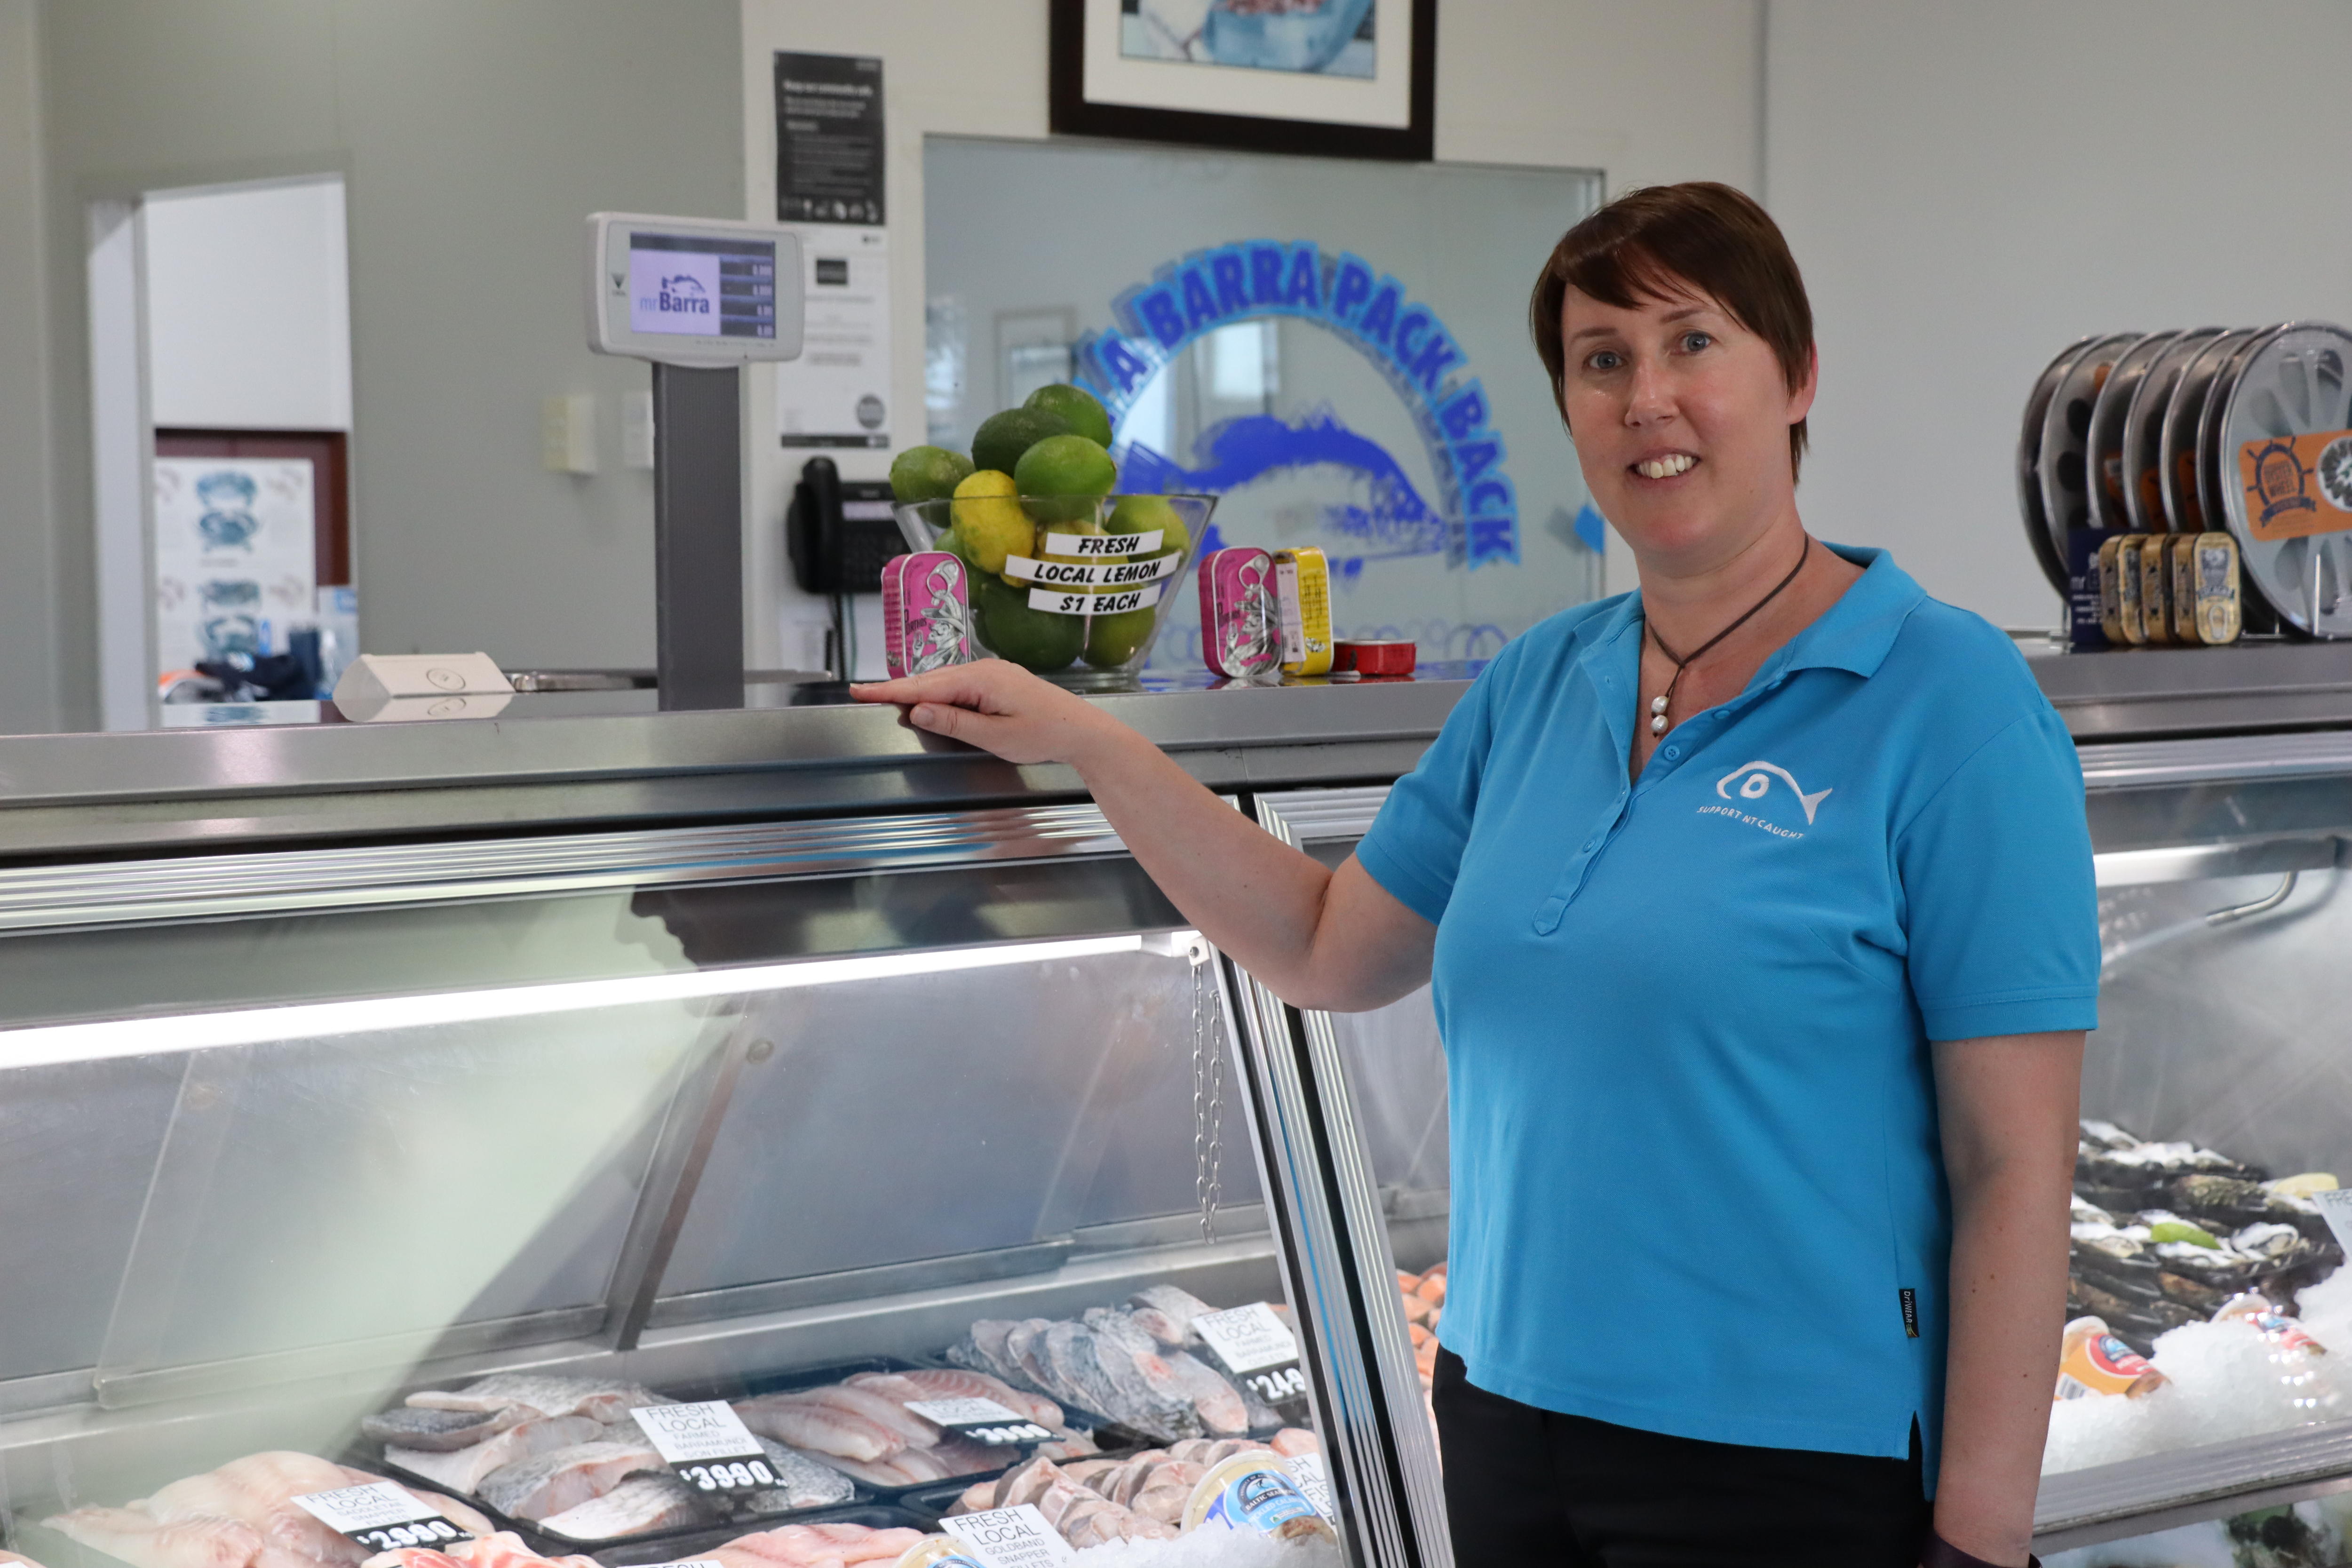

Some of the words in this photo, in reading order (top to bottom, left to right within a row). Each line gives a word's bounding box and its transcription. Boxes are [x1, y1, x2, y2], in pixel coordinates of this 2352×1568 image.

[1136, 242, 1322, 353] BARRA
[1333, 255, 1462, 396] PACK
[1437, 383, 1516, 565] BACK
[1078, 535, 1140, 555] FRESH
[1035, 564, 1095, 583] LOCAL
[1103, 560, 1162, 583] LEMON
[1060, 596, 1084, 612] $1
[1093, 592, 1141, 612] EACH
[1696, 806, 1742, 819] SUPPORT
[1757, 820, 1804, 839] CAUGHT
[1204, 1307, 1260, 1328] FRESH
[1217, 1321, 1272, 1341] LOCAL
[646, 1404, 715, 1420] FRESH
[659, 1417, 727, 1433] LOCAL
[674, 1430, 721, 1440] FARMED
[675, 1437, 747, 1450] BARRAMUNDI
[306, 1485, 379, 1504] FRESH
[326, 1493, 398, 1511] LOCAL
[1246, 1493, 1268, 1511] BALTIC
[954, 1509, 1024, 1531] FRESH
[973, 1523, 1041, 1546] LOCAL
[985, 1538, 1045, 1556] GOLDBAND
[998, 1548, 1050, 1565] SNAPPER
